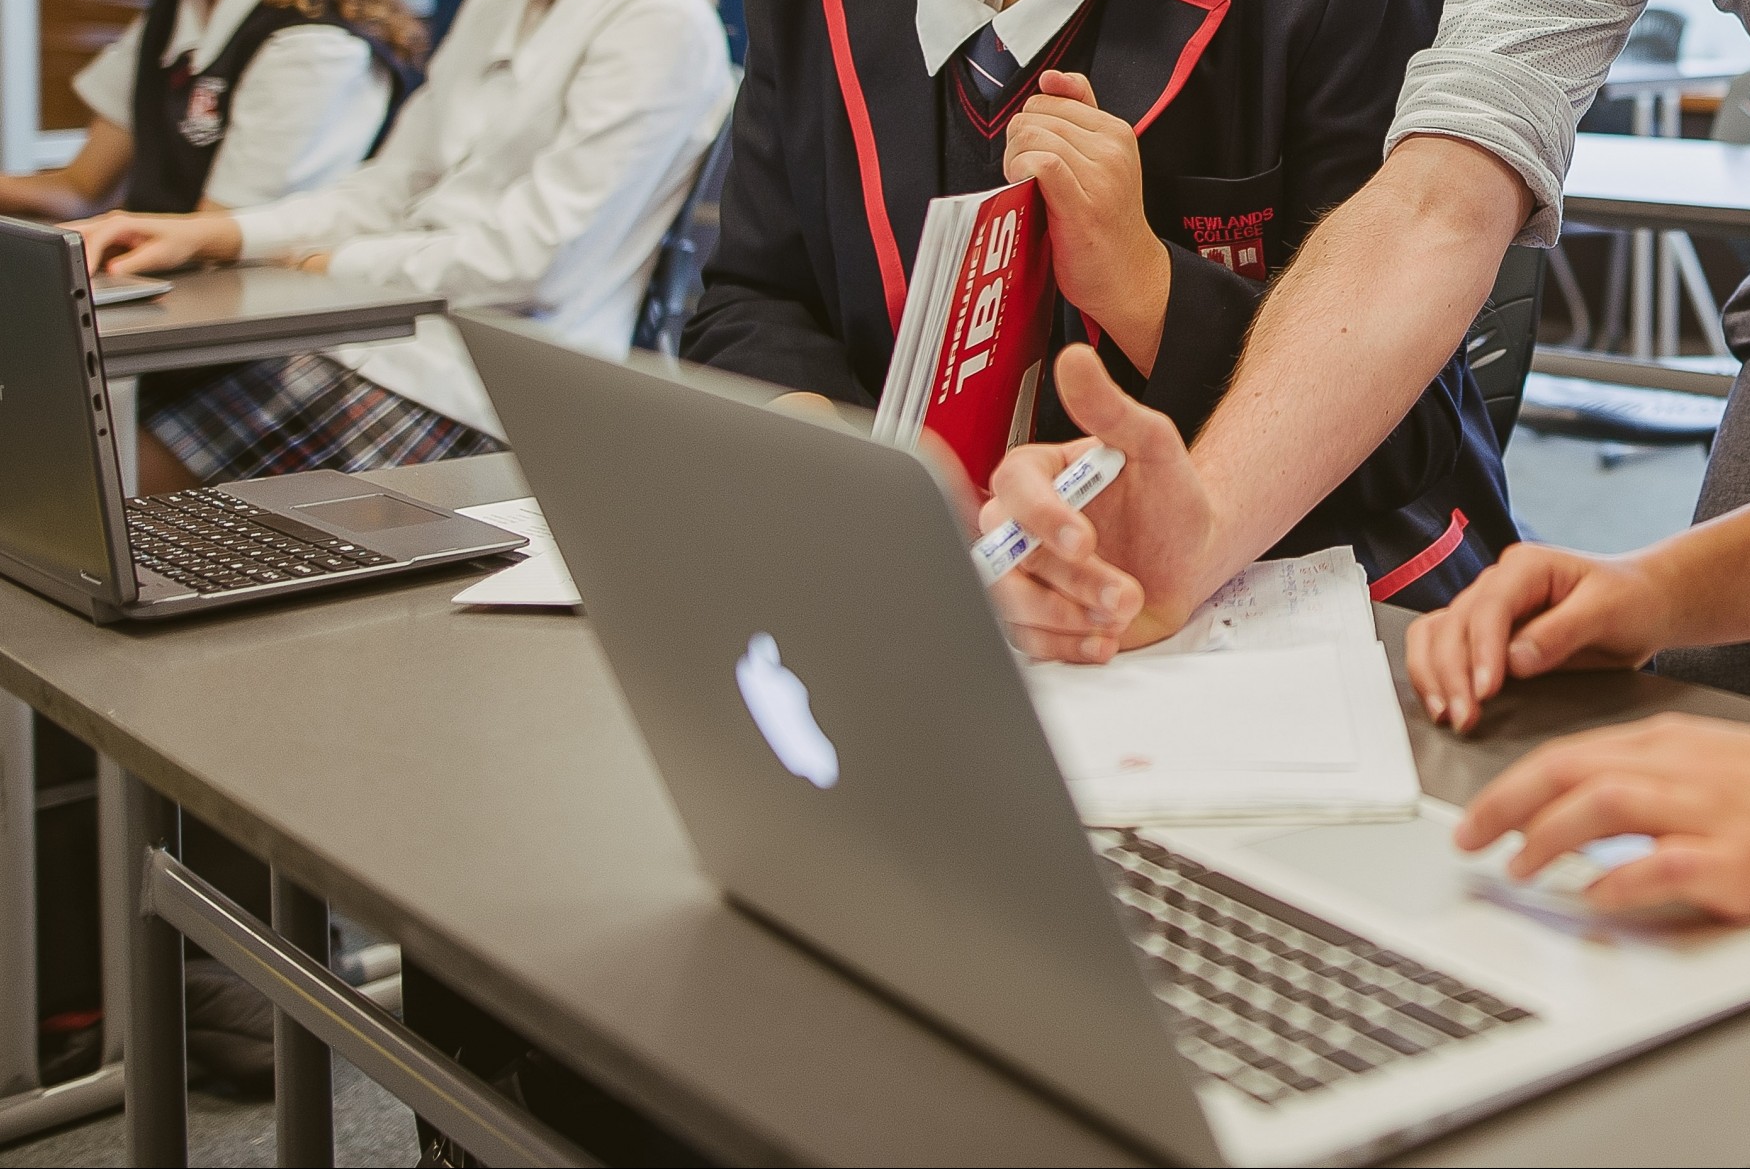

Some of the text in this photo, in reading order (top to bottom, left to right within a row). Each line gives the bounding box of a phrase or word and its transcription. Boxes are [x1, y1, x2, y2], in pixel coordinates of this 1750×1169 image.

[1183, 208, 1274, 230] NEWLANDS
[1193, 224, 1263, 243] COLLEGE
[938, 220, 988, 404] WARWICK
[955, 209, 1017, 395] 1B5
